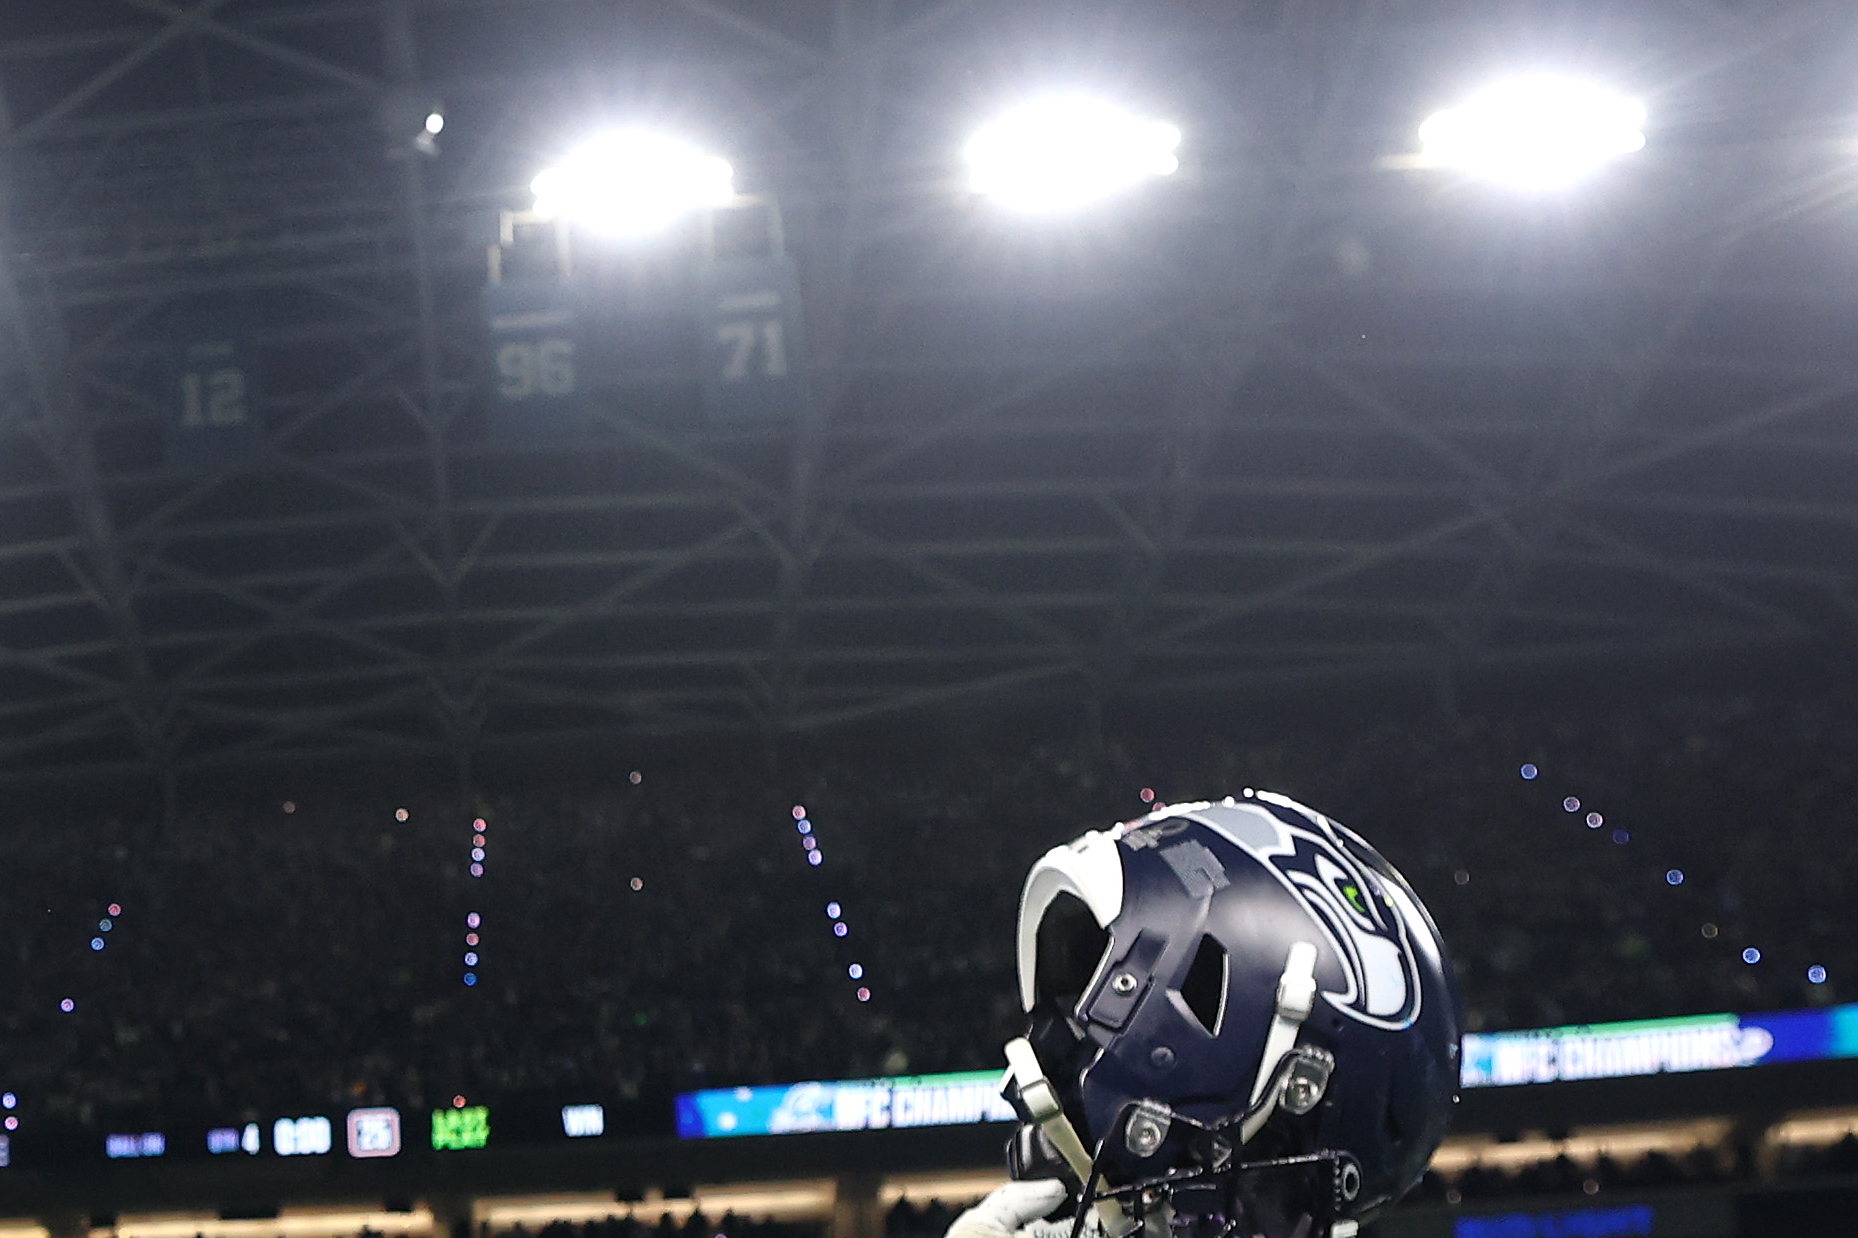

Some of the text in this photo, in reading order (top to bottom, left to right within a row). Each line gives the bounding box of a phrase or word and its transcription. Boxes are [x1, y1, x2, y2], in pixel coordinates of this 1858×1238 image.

[497, 341, 576, 397] 96
[718, 322, 788, 380] 71
[183, 368, 245, 424] 12
